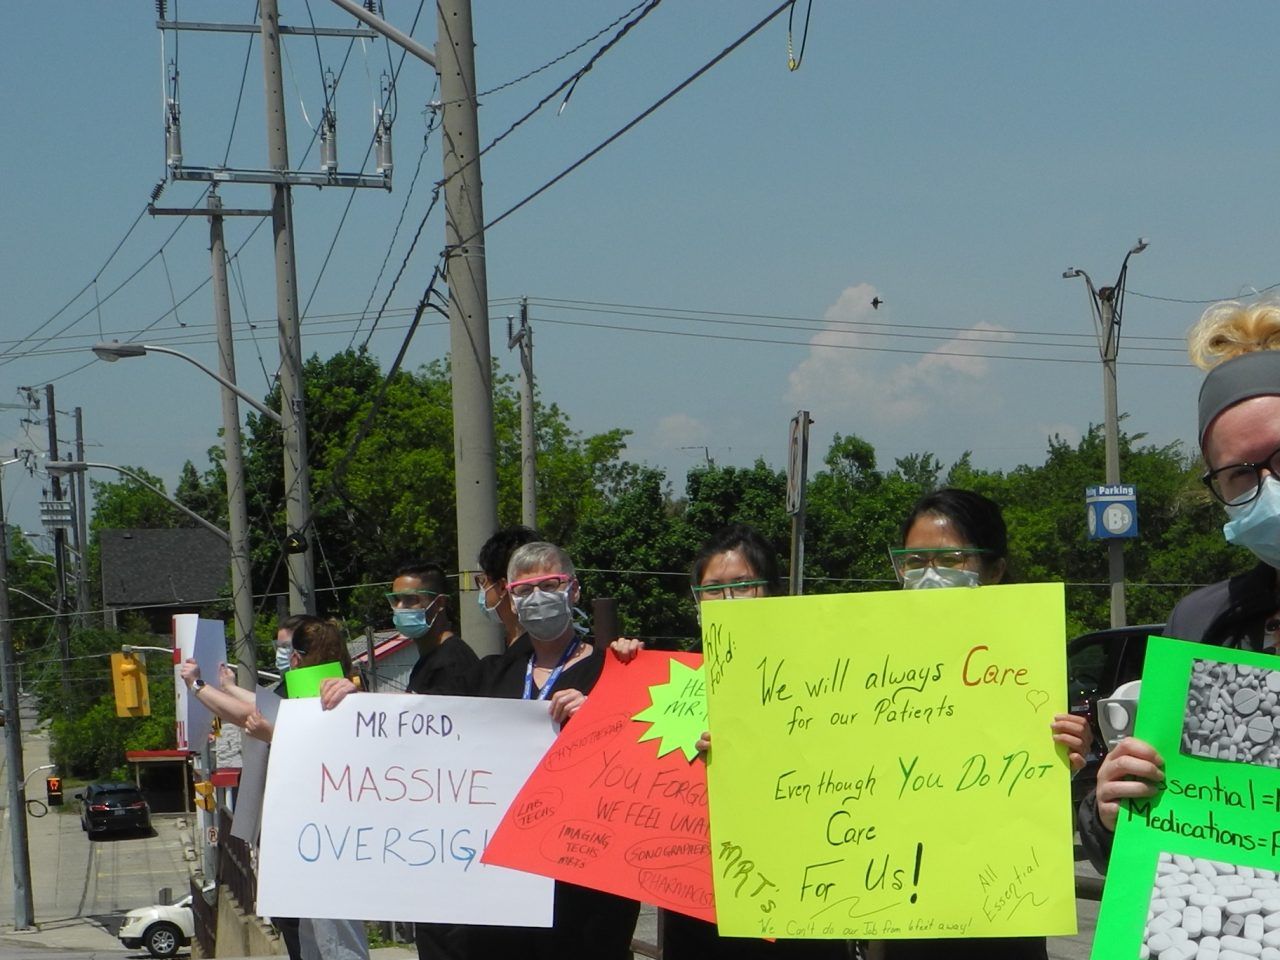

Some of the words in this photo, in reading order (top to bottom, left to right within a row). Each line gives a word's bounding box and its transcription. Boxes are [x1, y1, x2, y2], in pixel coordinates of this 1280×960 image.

[1099, 486, 1134, 496] Parking
[757, 656, 793, 706] We
[805, 658, 850, 697] will
[865, 654, 945, 702] always
[961, 645, 1030, 687] Care
[356, 711, 388, 739] MR
[397, 711, 461, 741] FORD,
[664, 700, 704, 717] MR.
[787, 706, 814, 735] for
[830, 712, 859, 726] our
[873, 695, 956, 726] Patients
[320, 762, 497, 805] MASSIVE
[589, 750, 643, 793] YOU
[775, 770, 811, 803] Even
[816, 765, 877, 805] though
[898, 755, 944, 799] You
[956, 753, 991, 792] Do
[1158, 776, 1255, 811] ssential
[520, 807, 555, 826] TECHS
[597, 797, 624, 823] WE
[624, 802, 661, 829] FEEL
[670, 812, 710, 837] UNA
[826, 810, 877, 846] Care
[298, 822, 489, 872] OVERSIG
[559, 824, 611, 850] IMAGING
[566, 842, 599, 858] TECHS
[801, 859, 845, 902] For
[865, 842, 923, 905] Us!
[979, 863, 998, 893] All
[983, 846, 1040, 922] Essential
[758, 918, 775, 935] We
[786, 920, 815, 936] Can't
[822, 922, 834, 935] do
[843, 927, 859, 936] our
[863, 921, 878, 936] Job
[882, 920, 901, 935] from
[938, 917, 973, 934] away!
